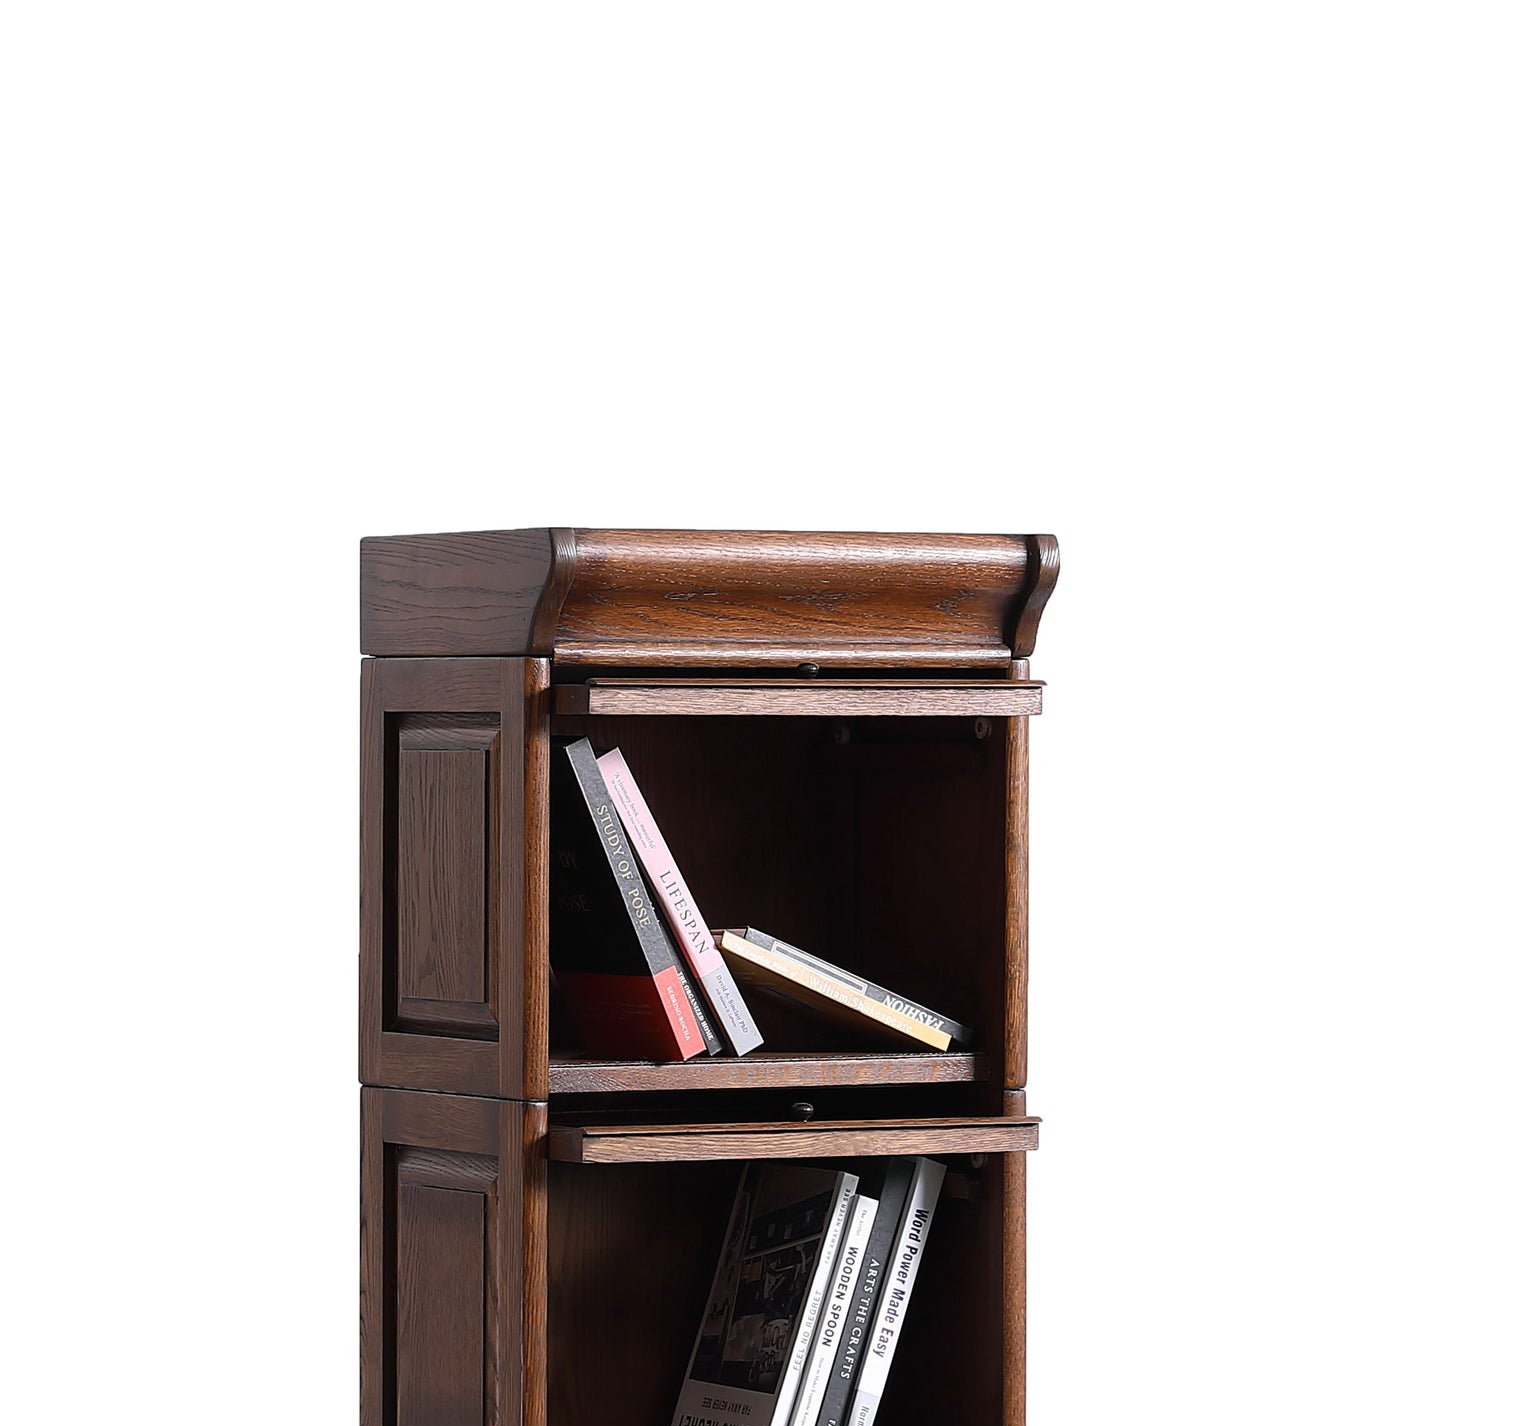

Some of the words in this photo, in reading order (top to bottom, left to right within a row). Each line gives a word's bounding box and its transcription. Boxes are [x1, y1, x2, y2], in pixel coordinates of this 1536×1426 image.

[596, 804, 625, 856] STUDY
[618, 860, 635, 880] OF
[628, 888, 651, 928] POSE
[659, 870, 710, 954] LIFESPAN
[678, 970, 688, 985] THE
[684, 984, 704, 1021] ORGANIZED
[700, 1020, 715, 1041] HOME
[716, 974, 729, 992] David
[729, 999, 742, 1021] Sinclair
[808, 976, 849, 1004] William
[851, 997, 913, 1033] Shakespeare
[882, 994, 945, 1031] FASHION
[824, 1249, 834, 1264] FAR
[829, 1227, 841, 1250] AWAY
[836, 1203, 847, 1227] NEVER
[908, 1208, 930, 1243] Word
[836, 1245, 859, 1301] WOODEN
[863, 1258, 881, 1294] ARTS
[895, 1244, 918, 1285] Power
[821, 1303, 842, 1347] SPOON
[855, 1297, 870, 1324] THE
[884, 1287, 906, 1324] Made
[793, 1346, 806, 1371] FEEL
[801, 1330, 811, 1346] NO
[806, 1290, 822, 1327] REGRET
[840, 1326, 862, 1380] CRAFTS
[872, 1326, 895, 1358] Easy
